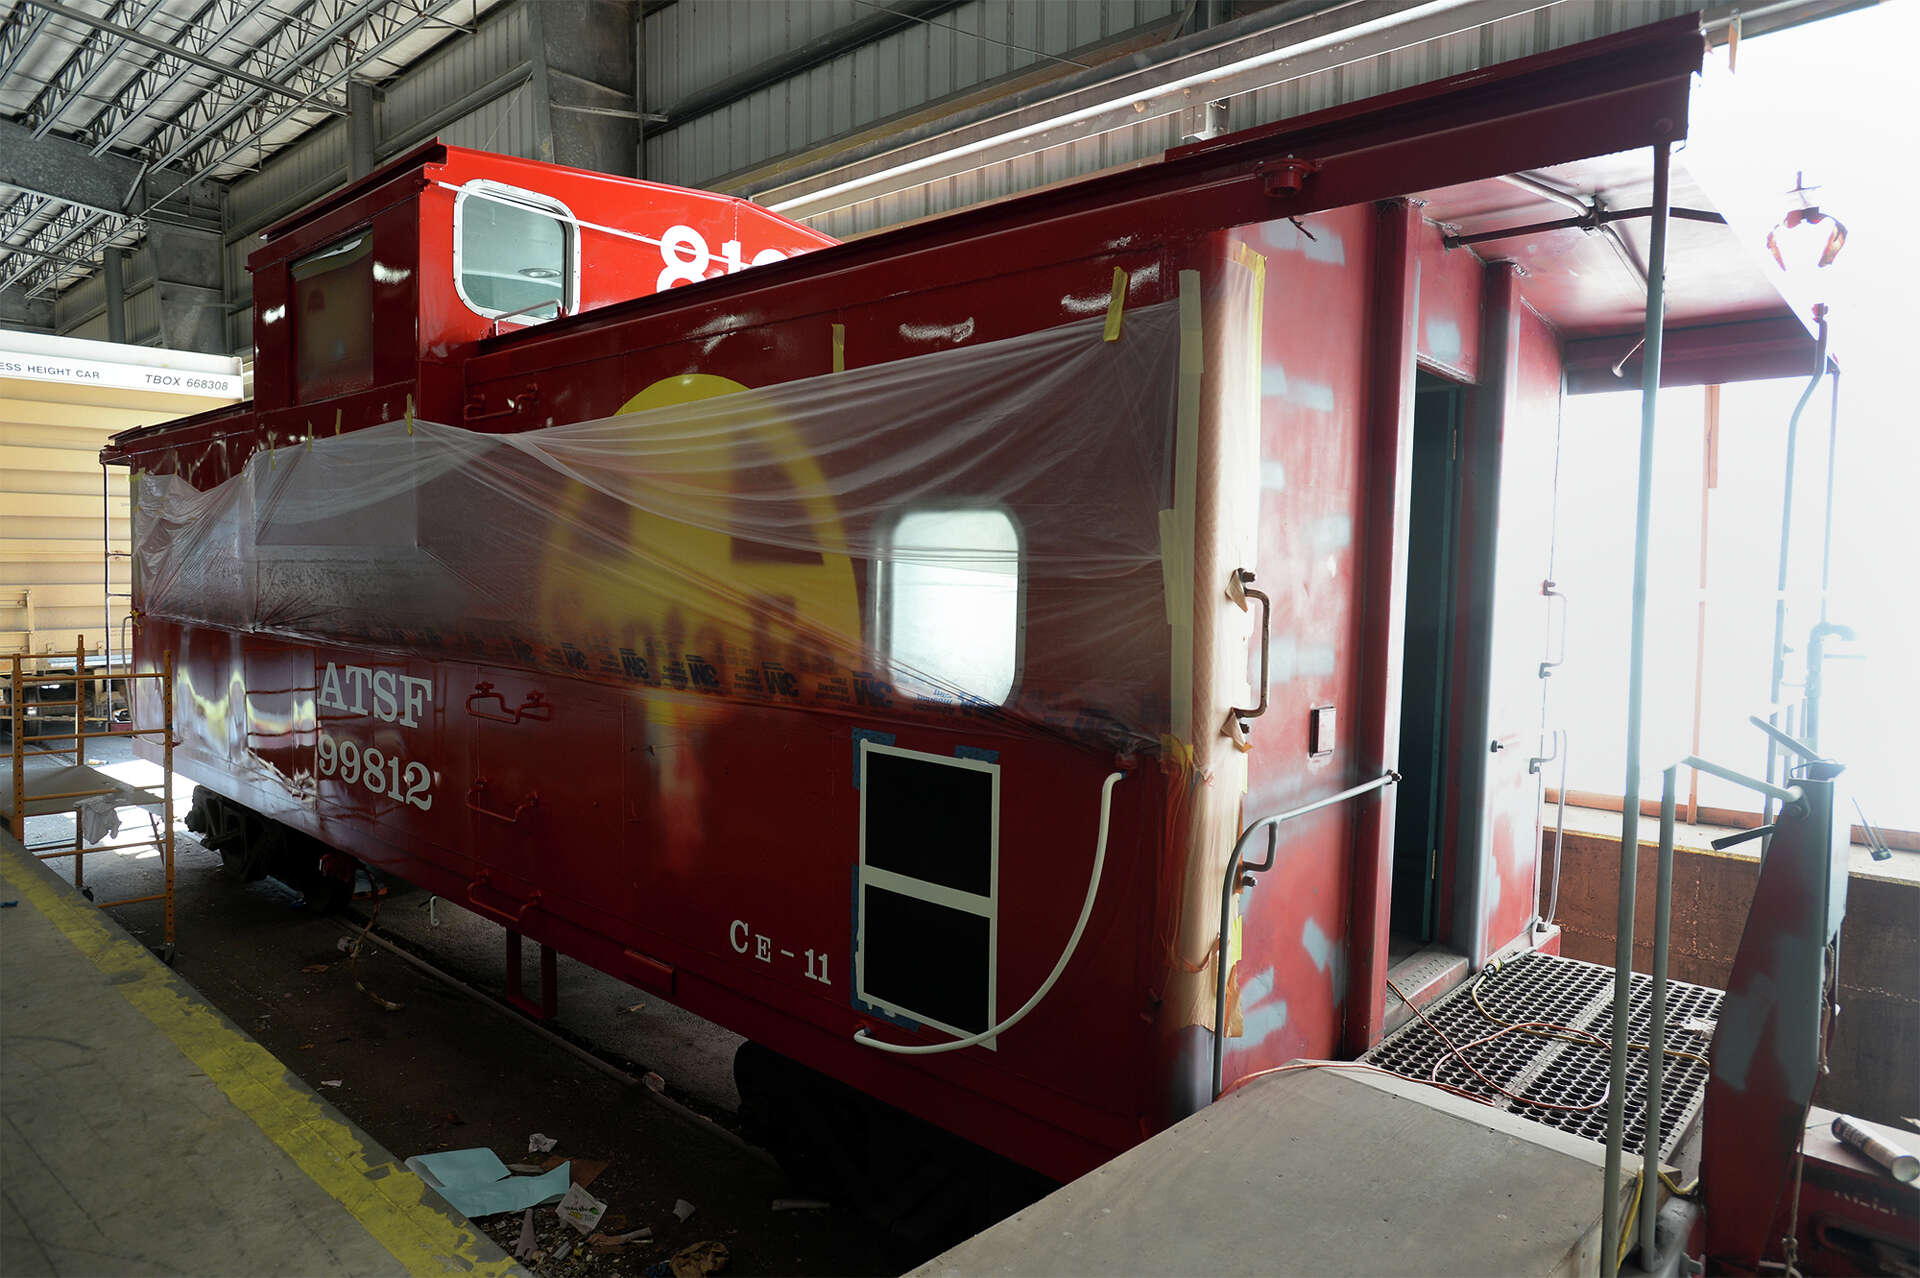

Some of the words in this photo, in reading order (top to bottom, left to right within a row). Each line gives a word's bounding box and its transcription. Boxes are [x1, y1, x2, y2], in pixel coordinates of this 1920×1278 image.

[27, 363, 71, 377] HEIGHT
[75, 369, 100, 380] CAR
[145, 374, 181, 387] TBOX
[186, 378, 229, 392] 668308
[317, 661, 433, 729] ATSF
[317, 734, 433, 811] 99812
